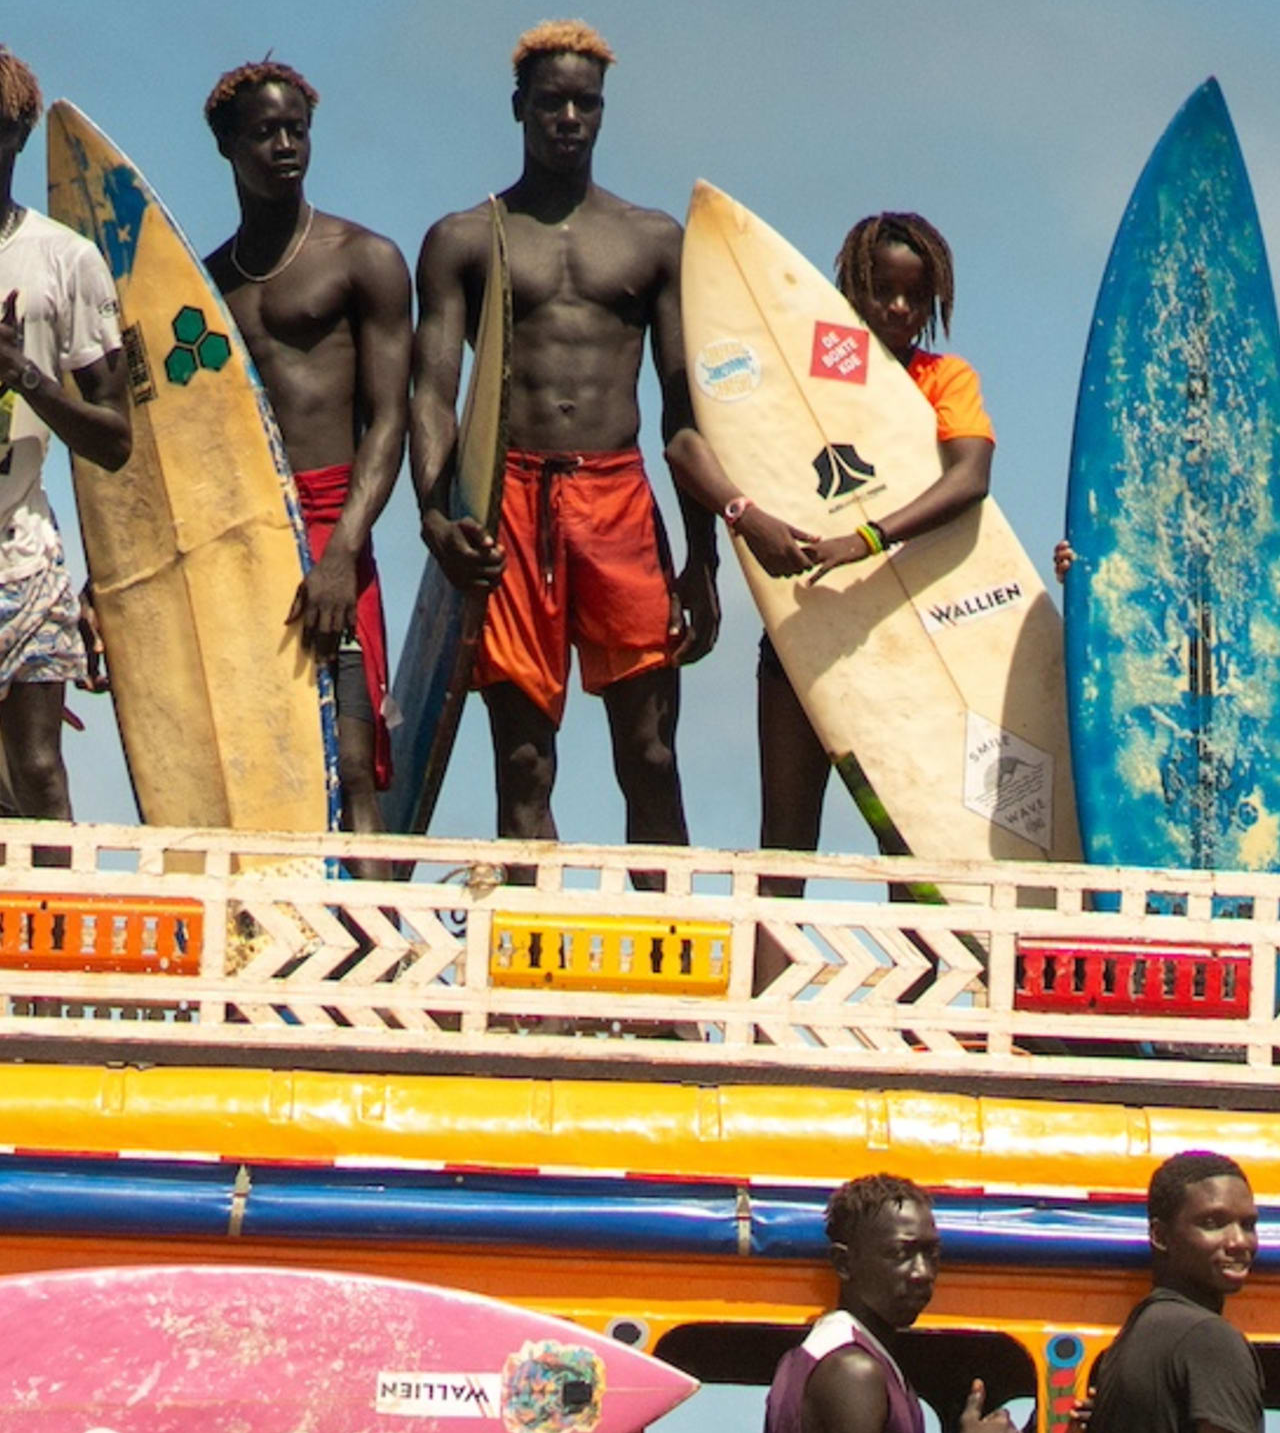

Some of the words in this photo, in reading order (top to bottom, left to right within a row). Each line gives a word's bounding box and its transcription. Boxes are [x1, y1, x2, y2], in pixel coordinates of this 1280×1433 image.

[821, 331, 840, 350] DE
[821, 336, 858, 368] BONTE
[837, 353, 863, 376] KOE
[928, 583, 1022, 624] WALLIEN
[969, 734, 1010, 762] SMILE
[1005, 798, 1045, 824] WAVE
[380, 1381, 489, 1403] WALLIEN
